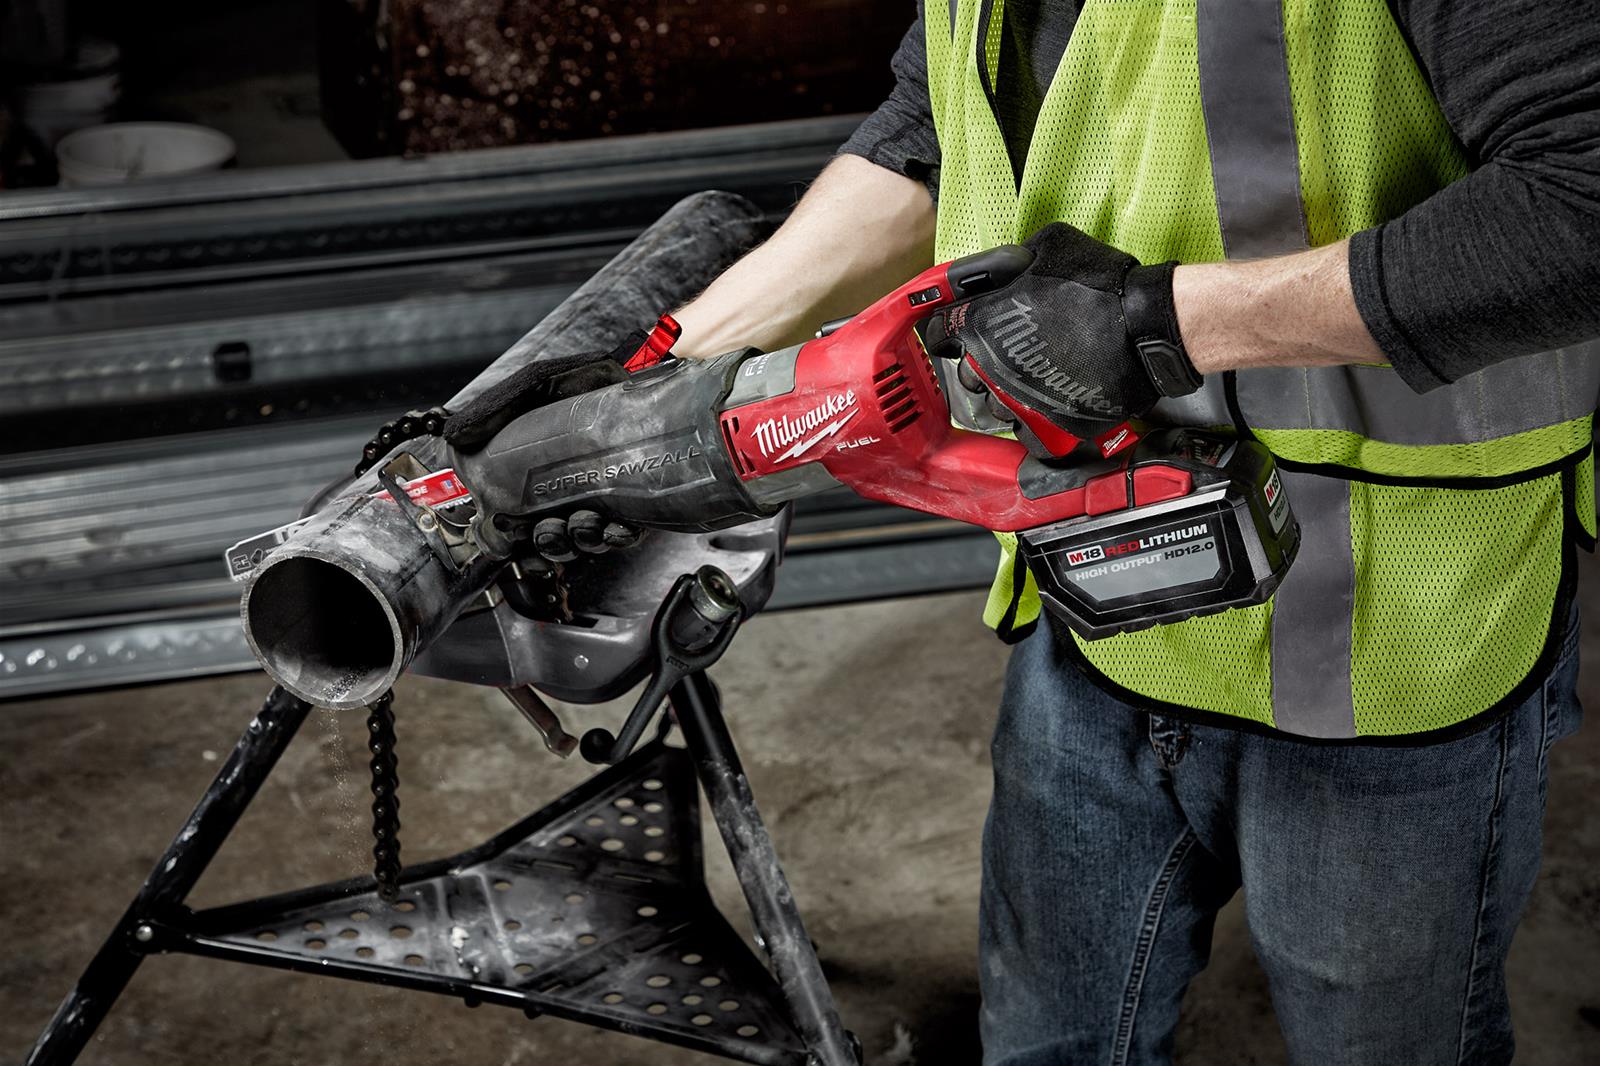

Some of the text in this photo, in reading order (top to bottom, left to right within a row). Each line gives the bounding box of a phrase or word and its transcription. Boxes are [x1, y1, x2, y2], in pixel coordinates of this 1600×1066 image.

[921, 293, 927, 302] 4
[987, 297, 1123, 415] Milwaukee
[751, 389, 857, 458] Milwaukee
[835, 436, 881, 452] FUEL
[534, 446, 701, 497] SUPER SAWZALL
[1069, 523, 1208, 564] M18 REDLITHIUM
[1075, 541, 1215, 581] HIGH OUTPUT HD12.0
